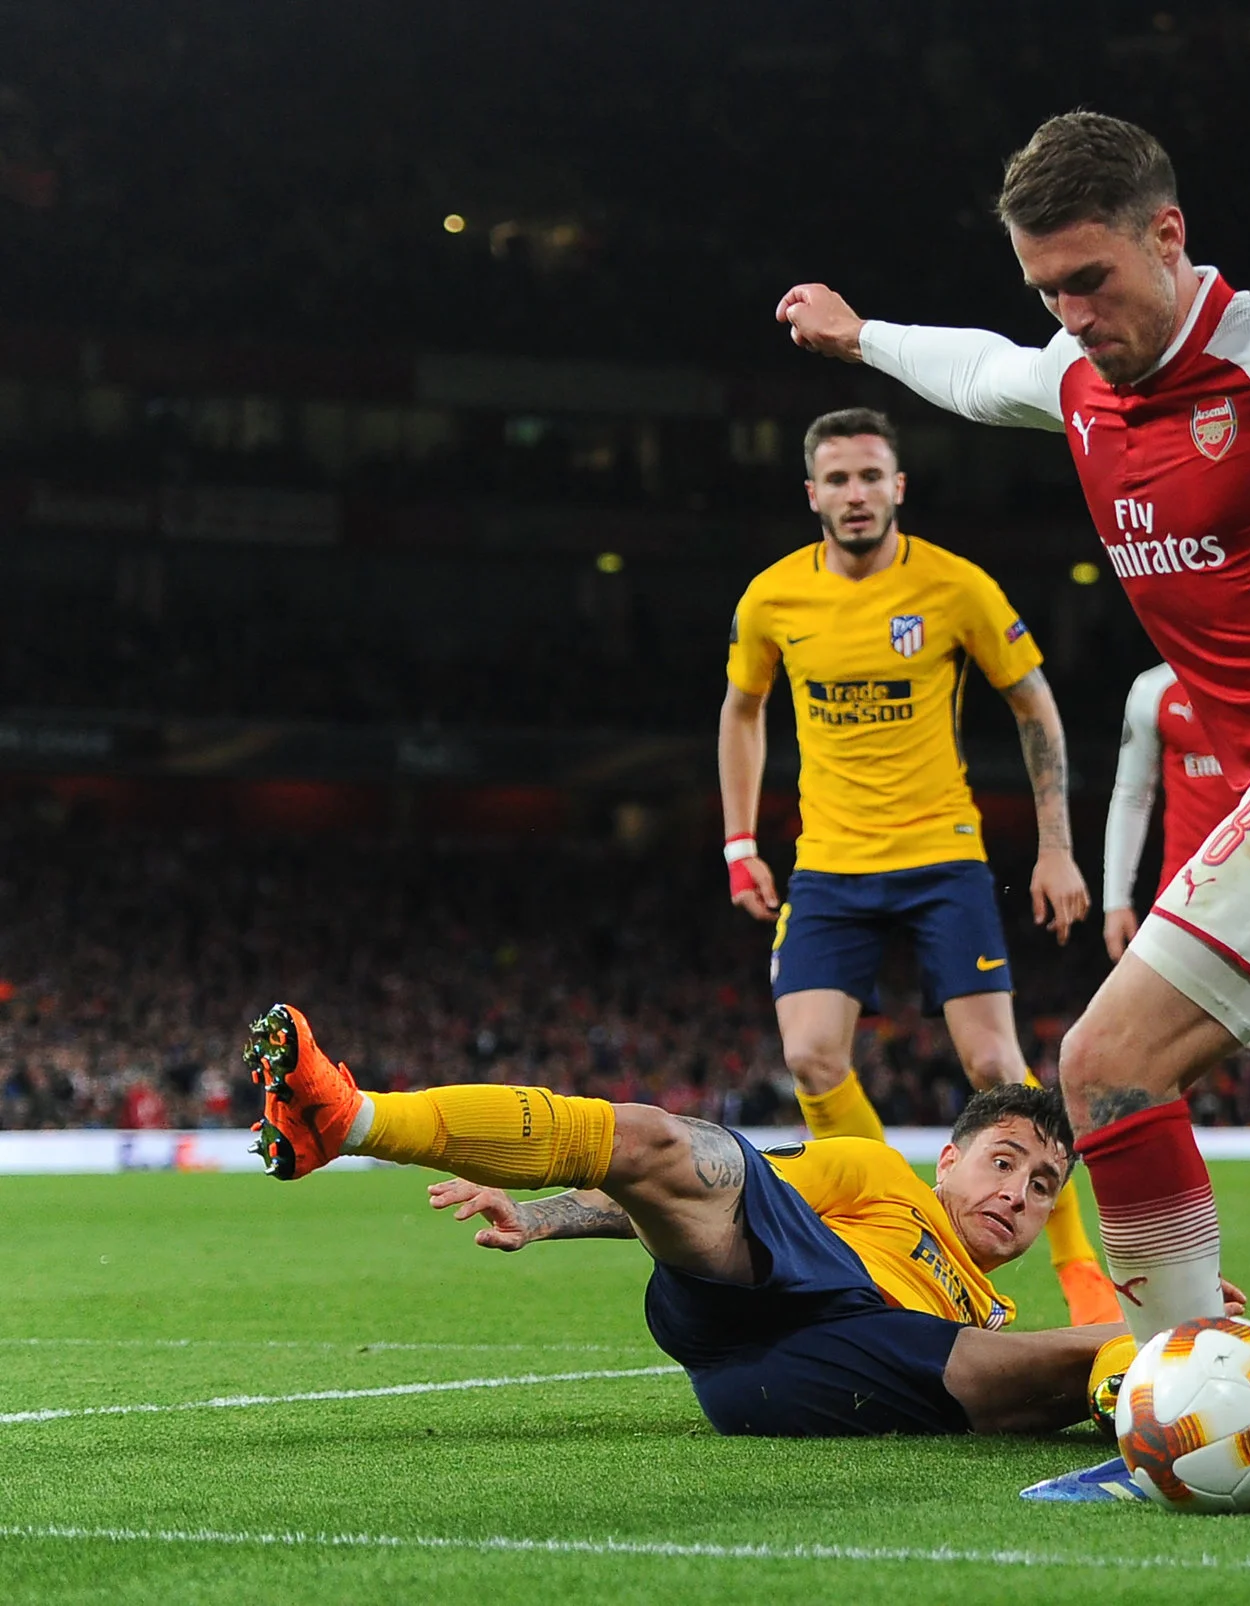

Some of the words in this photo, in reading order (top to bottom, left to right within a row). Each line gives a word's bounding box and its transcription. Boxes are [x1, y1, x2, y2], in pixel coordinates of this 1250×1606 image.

[1114, 498, 1153, 534] Fly
[1100, 532, 1226, 578] mirates
[822, 680, 889, 701] Trade
